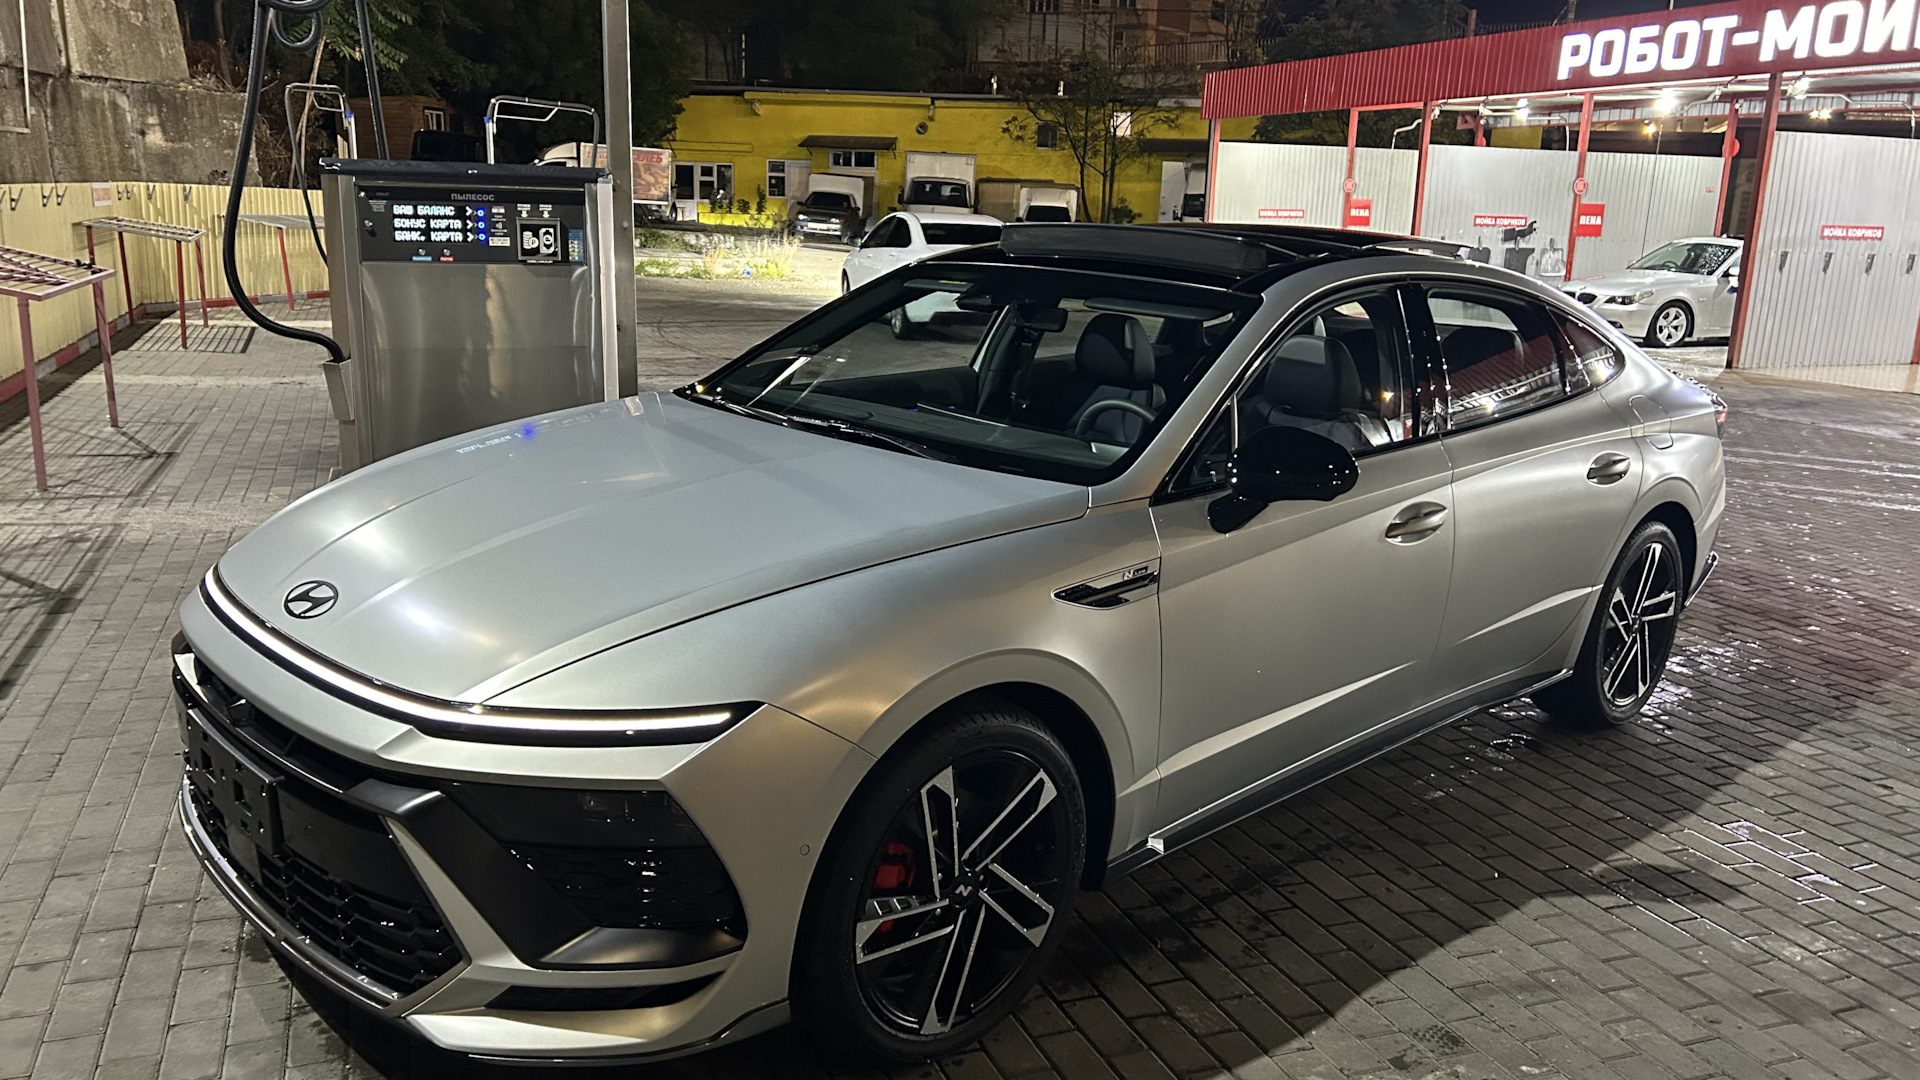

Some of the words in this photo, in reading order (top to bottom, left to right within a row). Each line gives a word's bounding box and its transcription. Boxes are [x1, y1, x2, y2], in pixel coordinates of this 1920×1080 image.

[451, 193, 495, 201] ПЫЛЕСОС
[393, 205, 414, 215] ВАШ
[417, 206, 455, 216] БАЛАНС
[1350, 208, 1369, 216] ПЕНА
[394, 218, 426, 228] БОНУС
[430, 219, 462, 229] КАРТА
[1495, 218, 1526, 226] КОВРИКОВ
[1579, 215, 1602, 225] ПЕНА
[395, 231, 425, 241] БАНК.
[431, 232, 463, 242] КАРТА
[1823, 227, 1847, 236] МОЙКА
[1847, 228, 1882, 237] КОВРИКОВ
[1123, 569, 1134, 579] N
